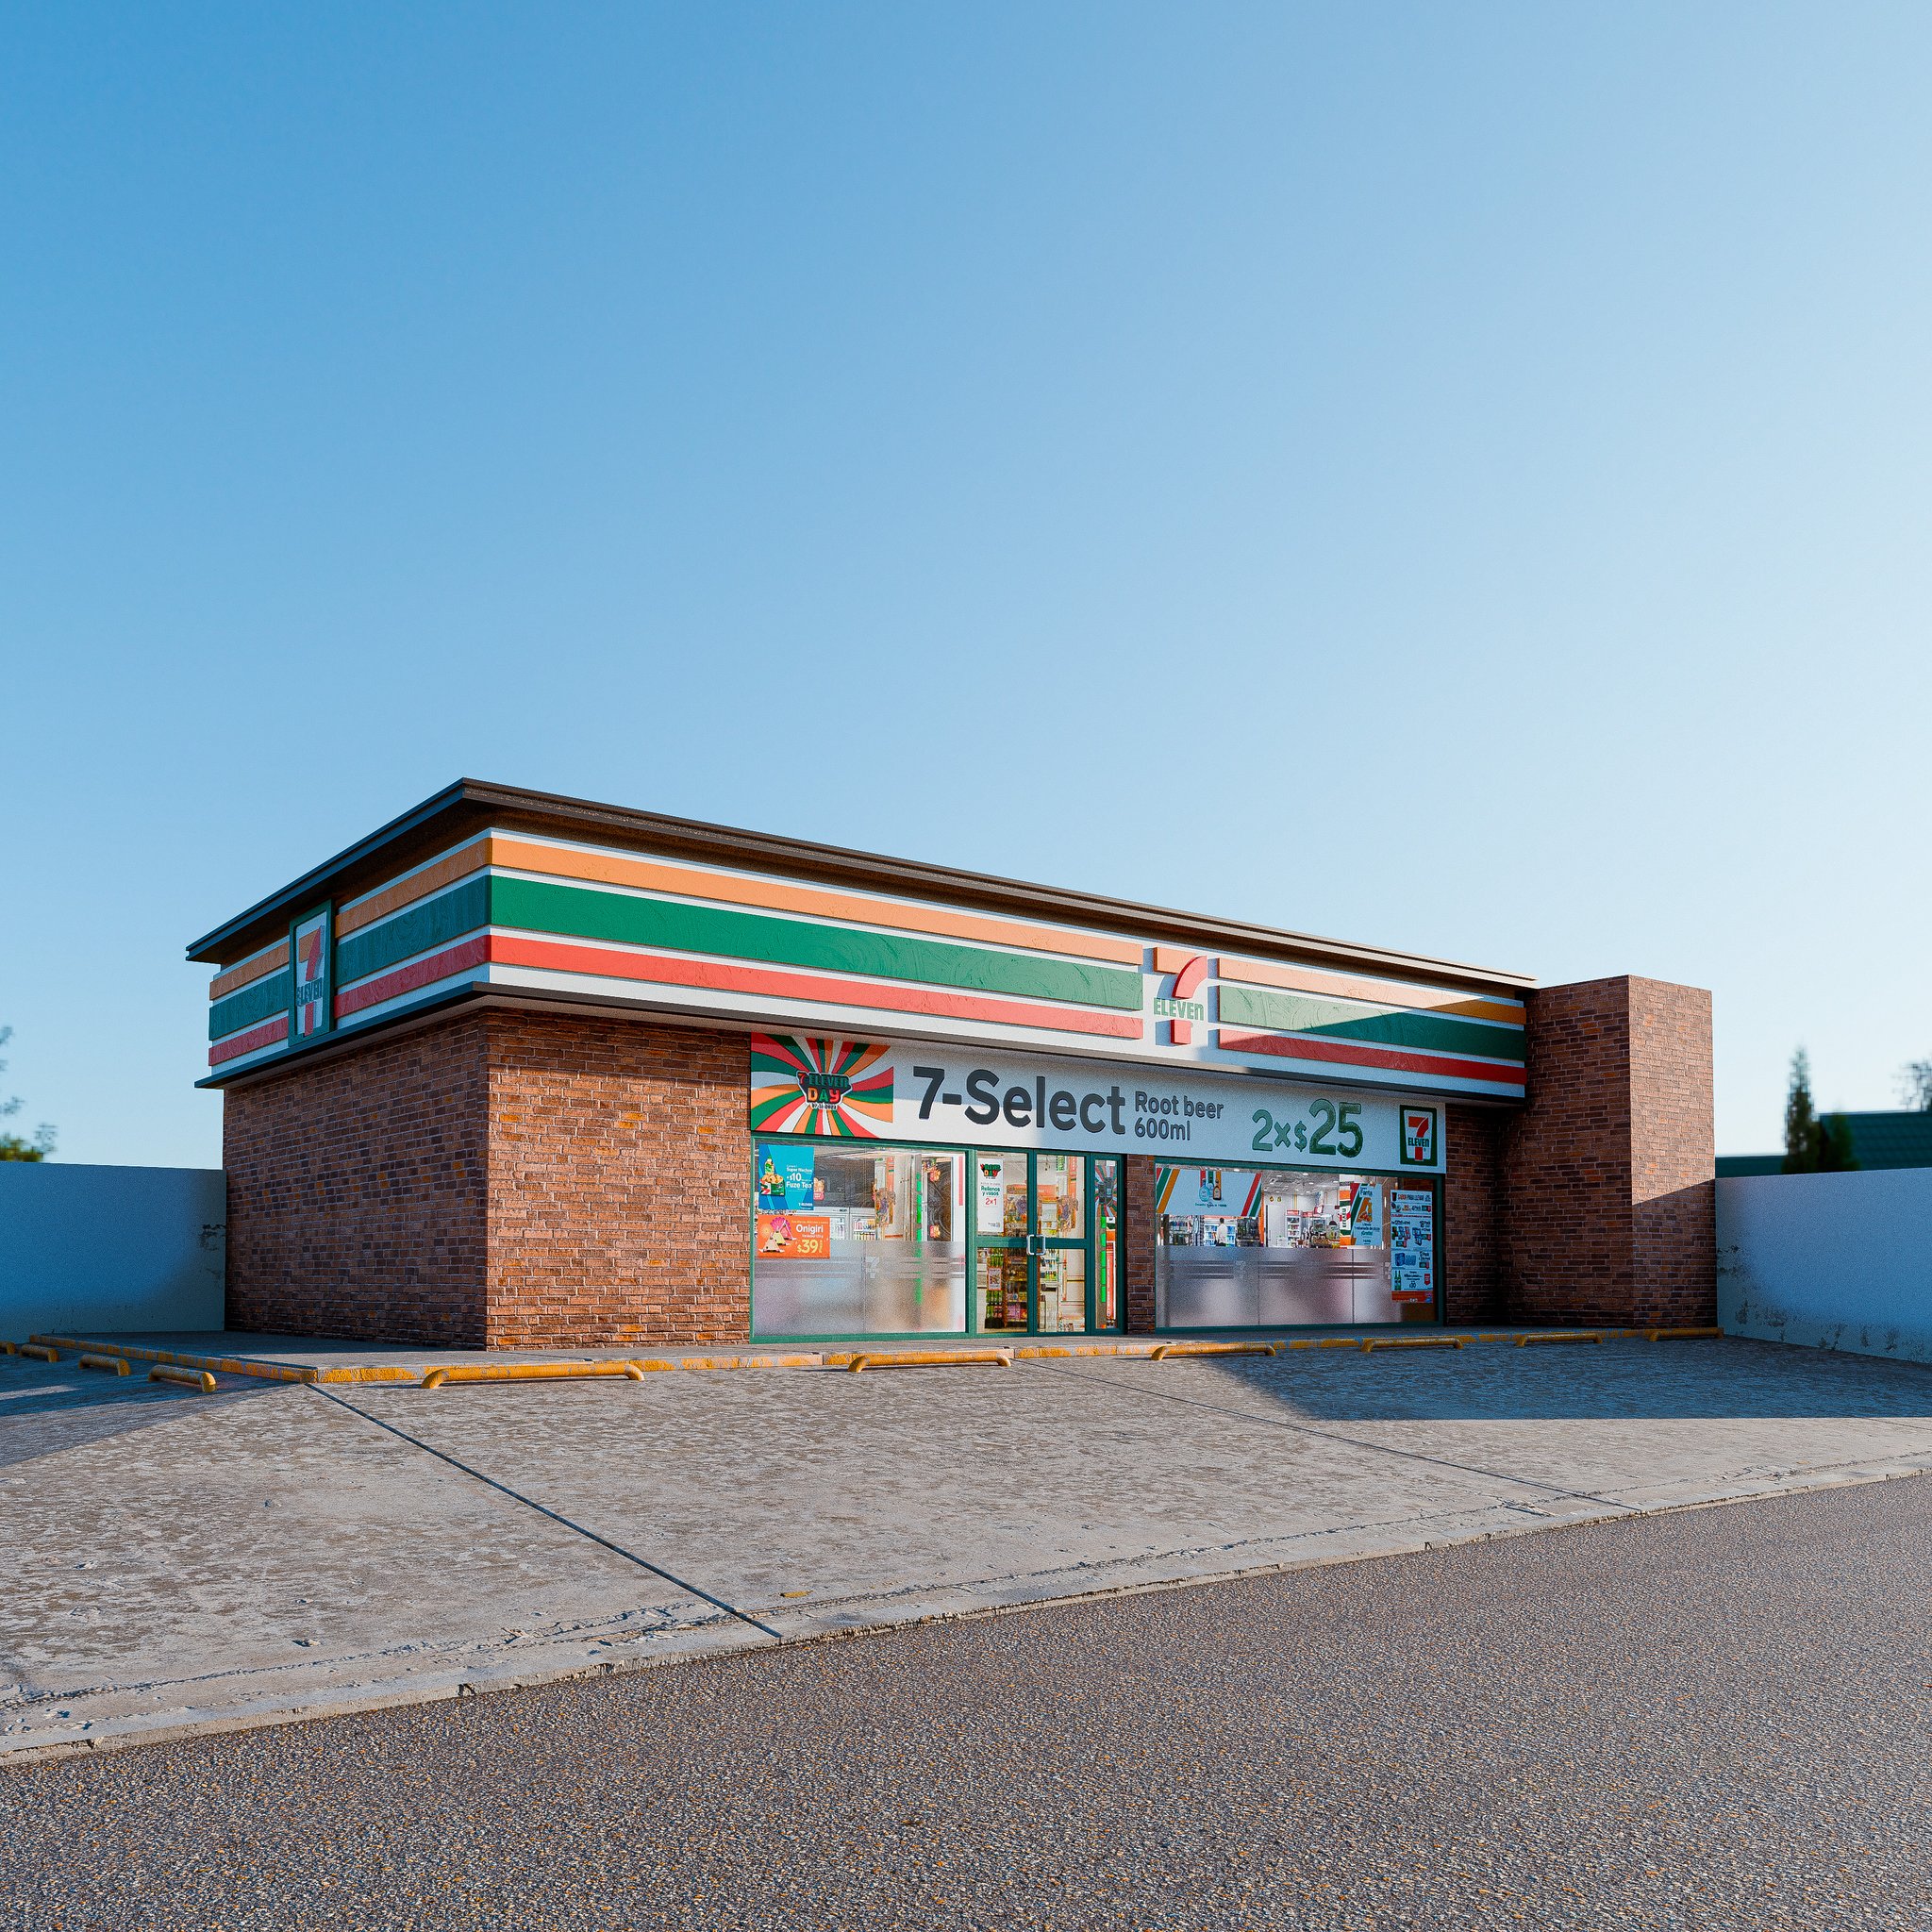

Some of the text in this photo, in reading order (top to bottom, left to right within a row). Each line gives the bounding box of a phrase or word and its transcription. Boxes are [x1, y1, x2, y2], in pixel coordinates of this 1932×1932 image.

[808, 1087, 841, 1103] DAY
[913, 1066, 1126, 1135] 7-Select
[1135, 1091, 1224, 1119] Root beer
[1134, 1117, 1191, 1141] 600ml
[795, 1224, 824, 1235] Onigiri
[796, 1239, 819, 1254] $39
